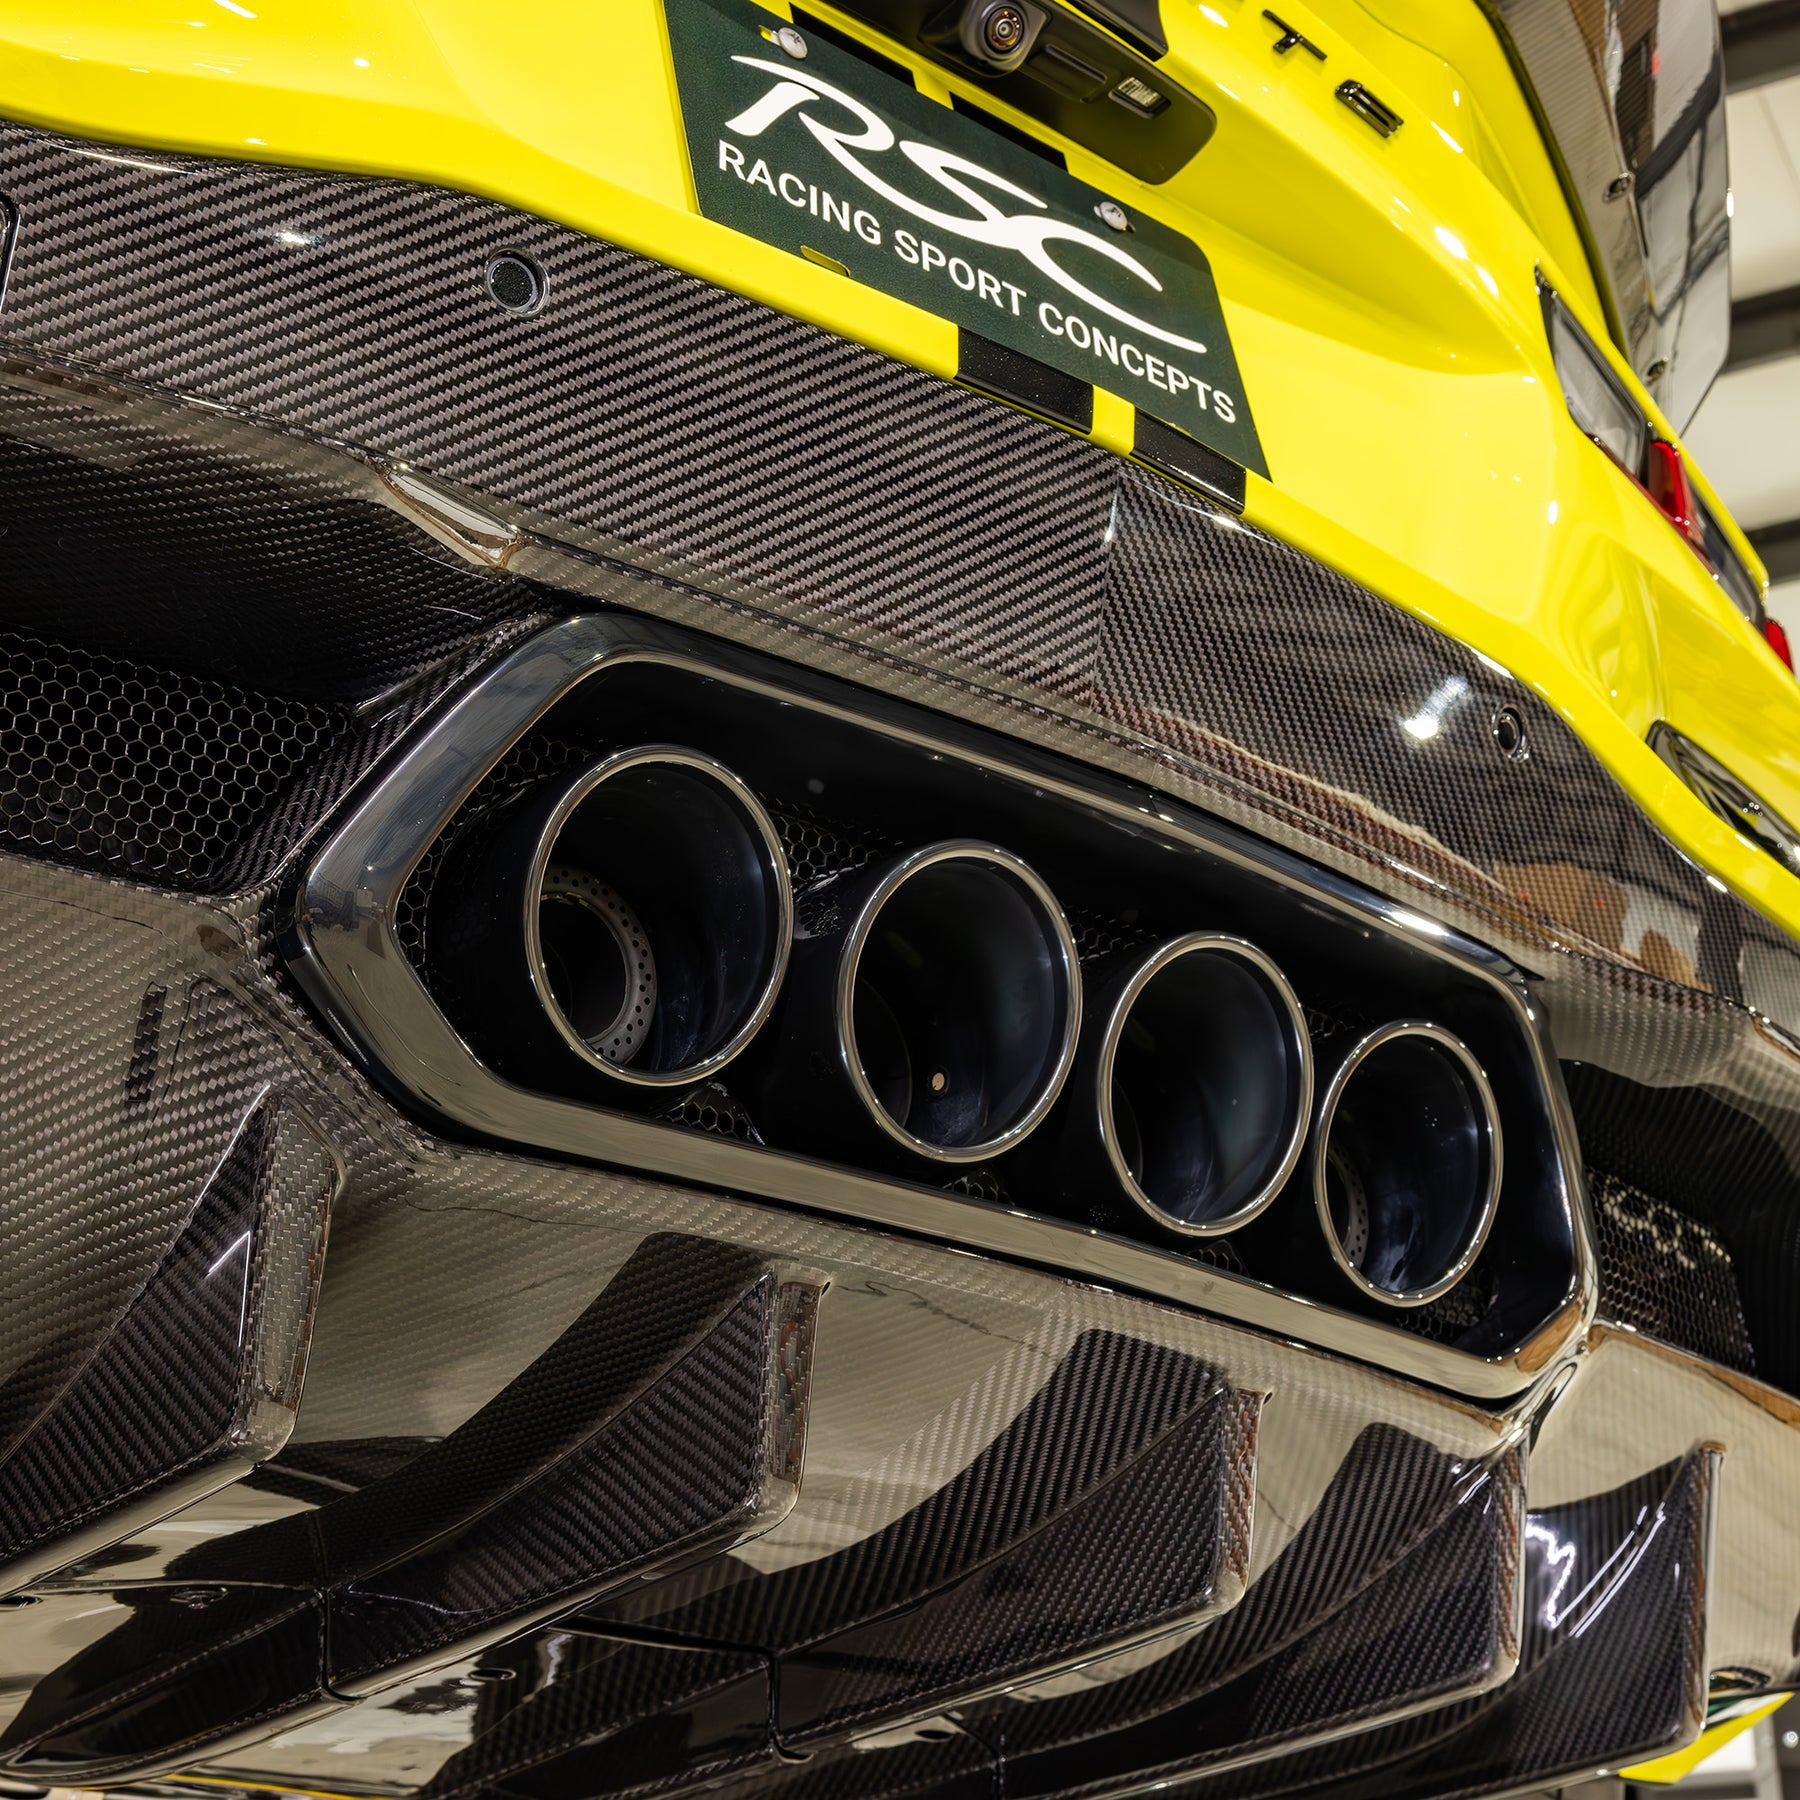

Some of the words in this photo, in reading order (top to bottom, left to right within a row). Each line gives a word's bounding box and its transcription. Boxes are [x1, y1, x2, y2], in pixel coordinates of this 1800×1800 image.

[718, 139, 882, 246] RACING
[894, 229, 1027, 316] SPORT
[1038, 302, 1236, 424] CONCEPTS
[724, 55, 1208, 354] RSC
